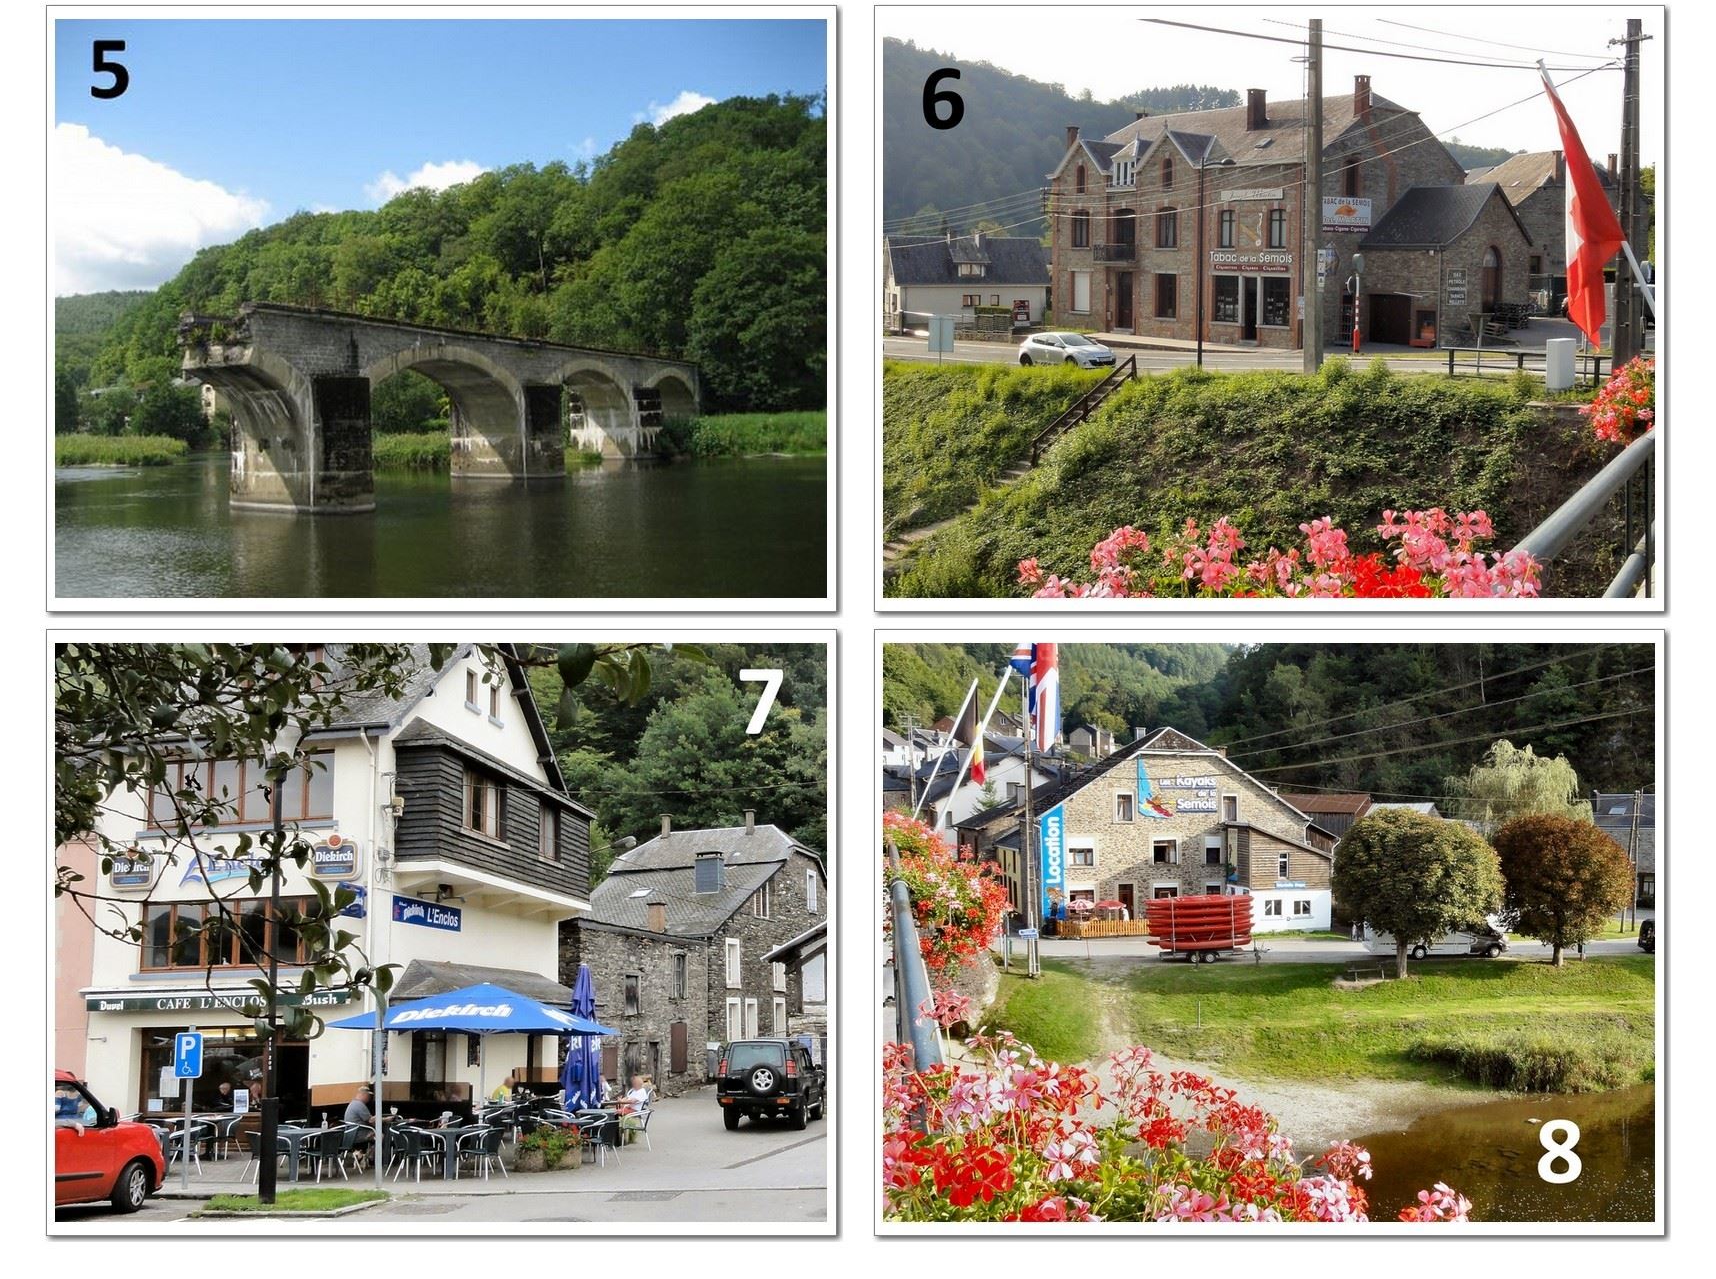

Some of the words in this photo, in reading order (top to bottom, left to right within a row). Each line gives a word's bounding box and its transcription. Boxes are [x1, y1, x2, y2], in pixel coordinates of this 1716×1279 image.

[1209, 251, 1237, 262] Tabac
[1259, 252, 1293, 263] Semois
[1175, 774, 1217, 788] Kayaks
[1176, 798, 1217, 809] Semois
[315, 850, 353, 862] Diekirch
[1045, 816, 1062, 884] Location
[427, 907, 459, 927] L'Enclos
[99, 1000, 124, 1011] Duvel
[156, 997, 191, 1010] CAFE
[302, 993, 338, 1005] Bush
[390, 1003, 514, 1024] Diekirch
[181, 1036, 196, 1060] P
